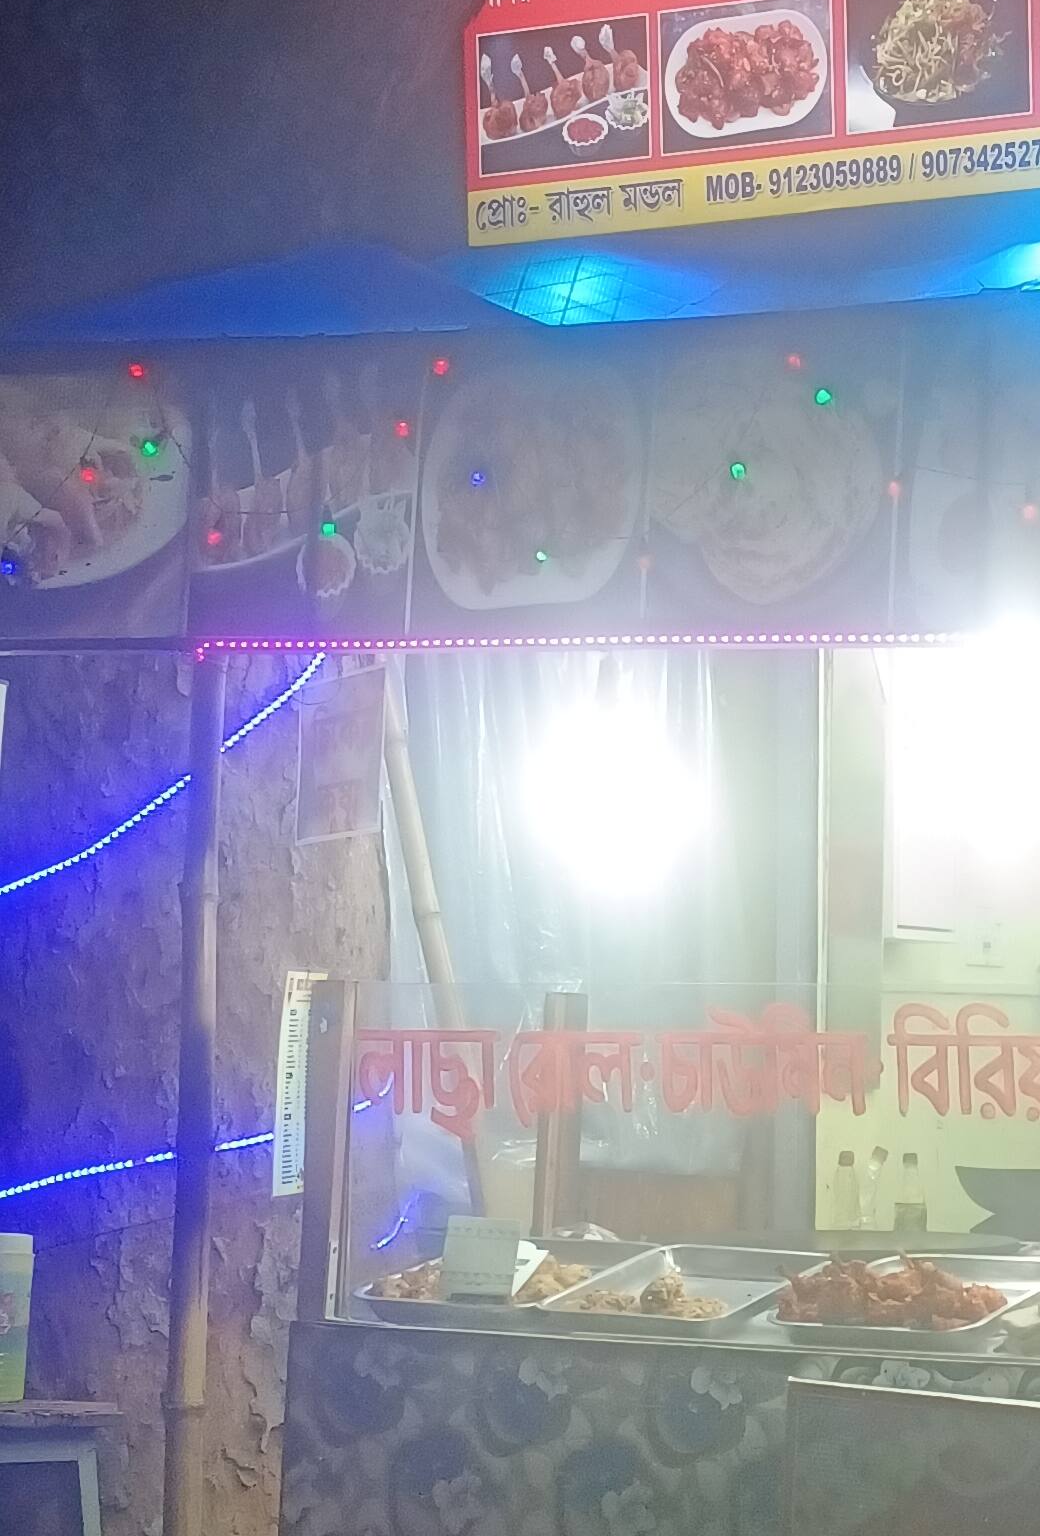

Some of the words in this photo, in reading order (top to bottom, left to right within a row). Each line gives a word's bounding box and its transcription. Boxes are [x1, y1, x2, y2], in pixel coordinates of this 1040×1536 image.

[545, 184, 614, 225] রাহুল
[706, 174, 763, 204] MOB-
[768, 154, 902, 198] 9123059889
